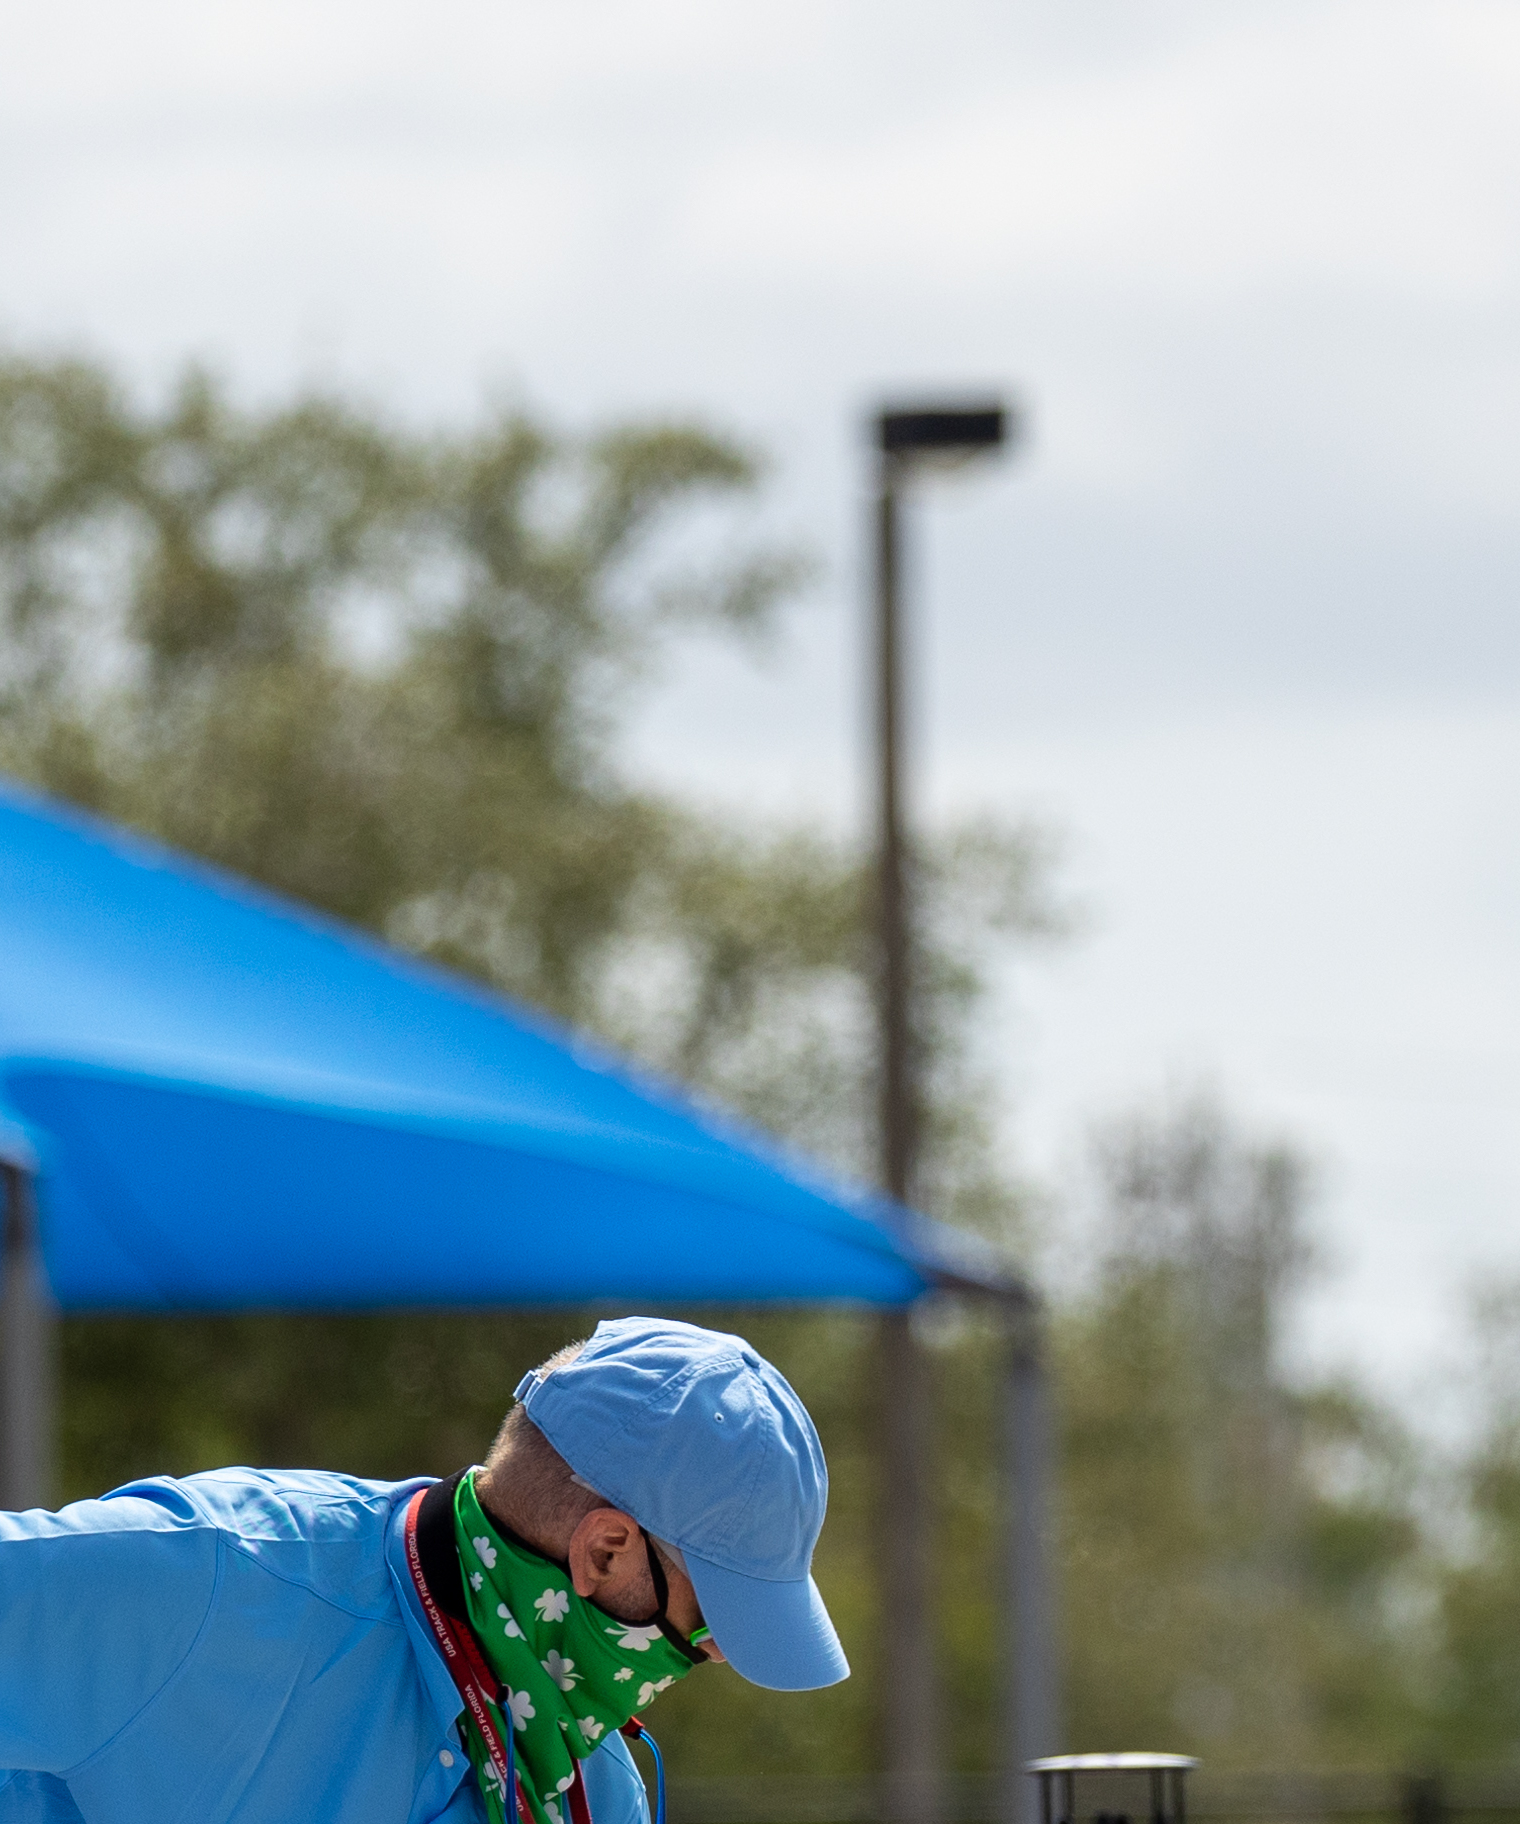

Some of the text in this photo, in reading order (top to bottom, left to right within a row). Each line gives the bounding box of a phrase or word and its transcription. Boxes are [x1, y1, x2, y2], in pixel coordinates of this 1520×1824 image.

[415, 1571, 429, 1597] FIELD
[428, 1606, 447, 1638] TRACK
[465, 1684, 487, 1724] FLORIDA
[482, 1725, 498, 1751] FIELD
